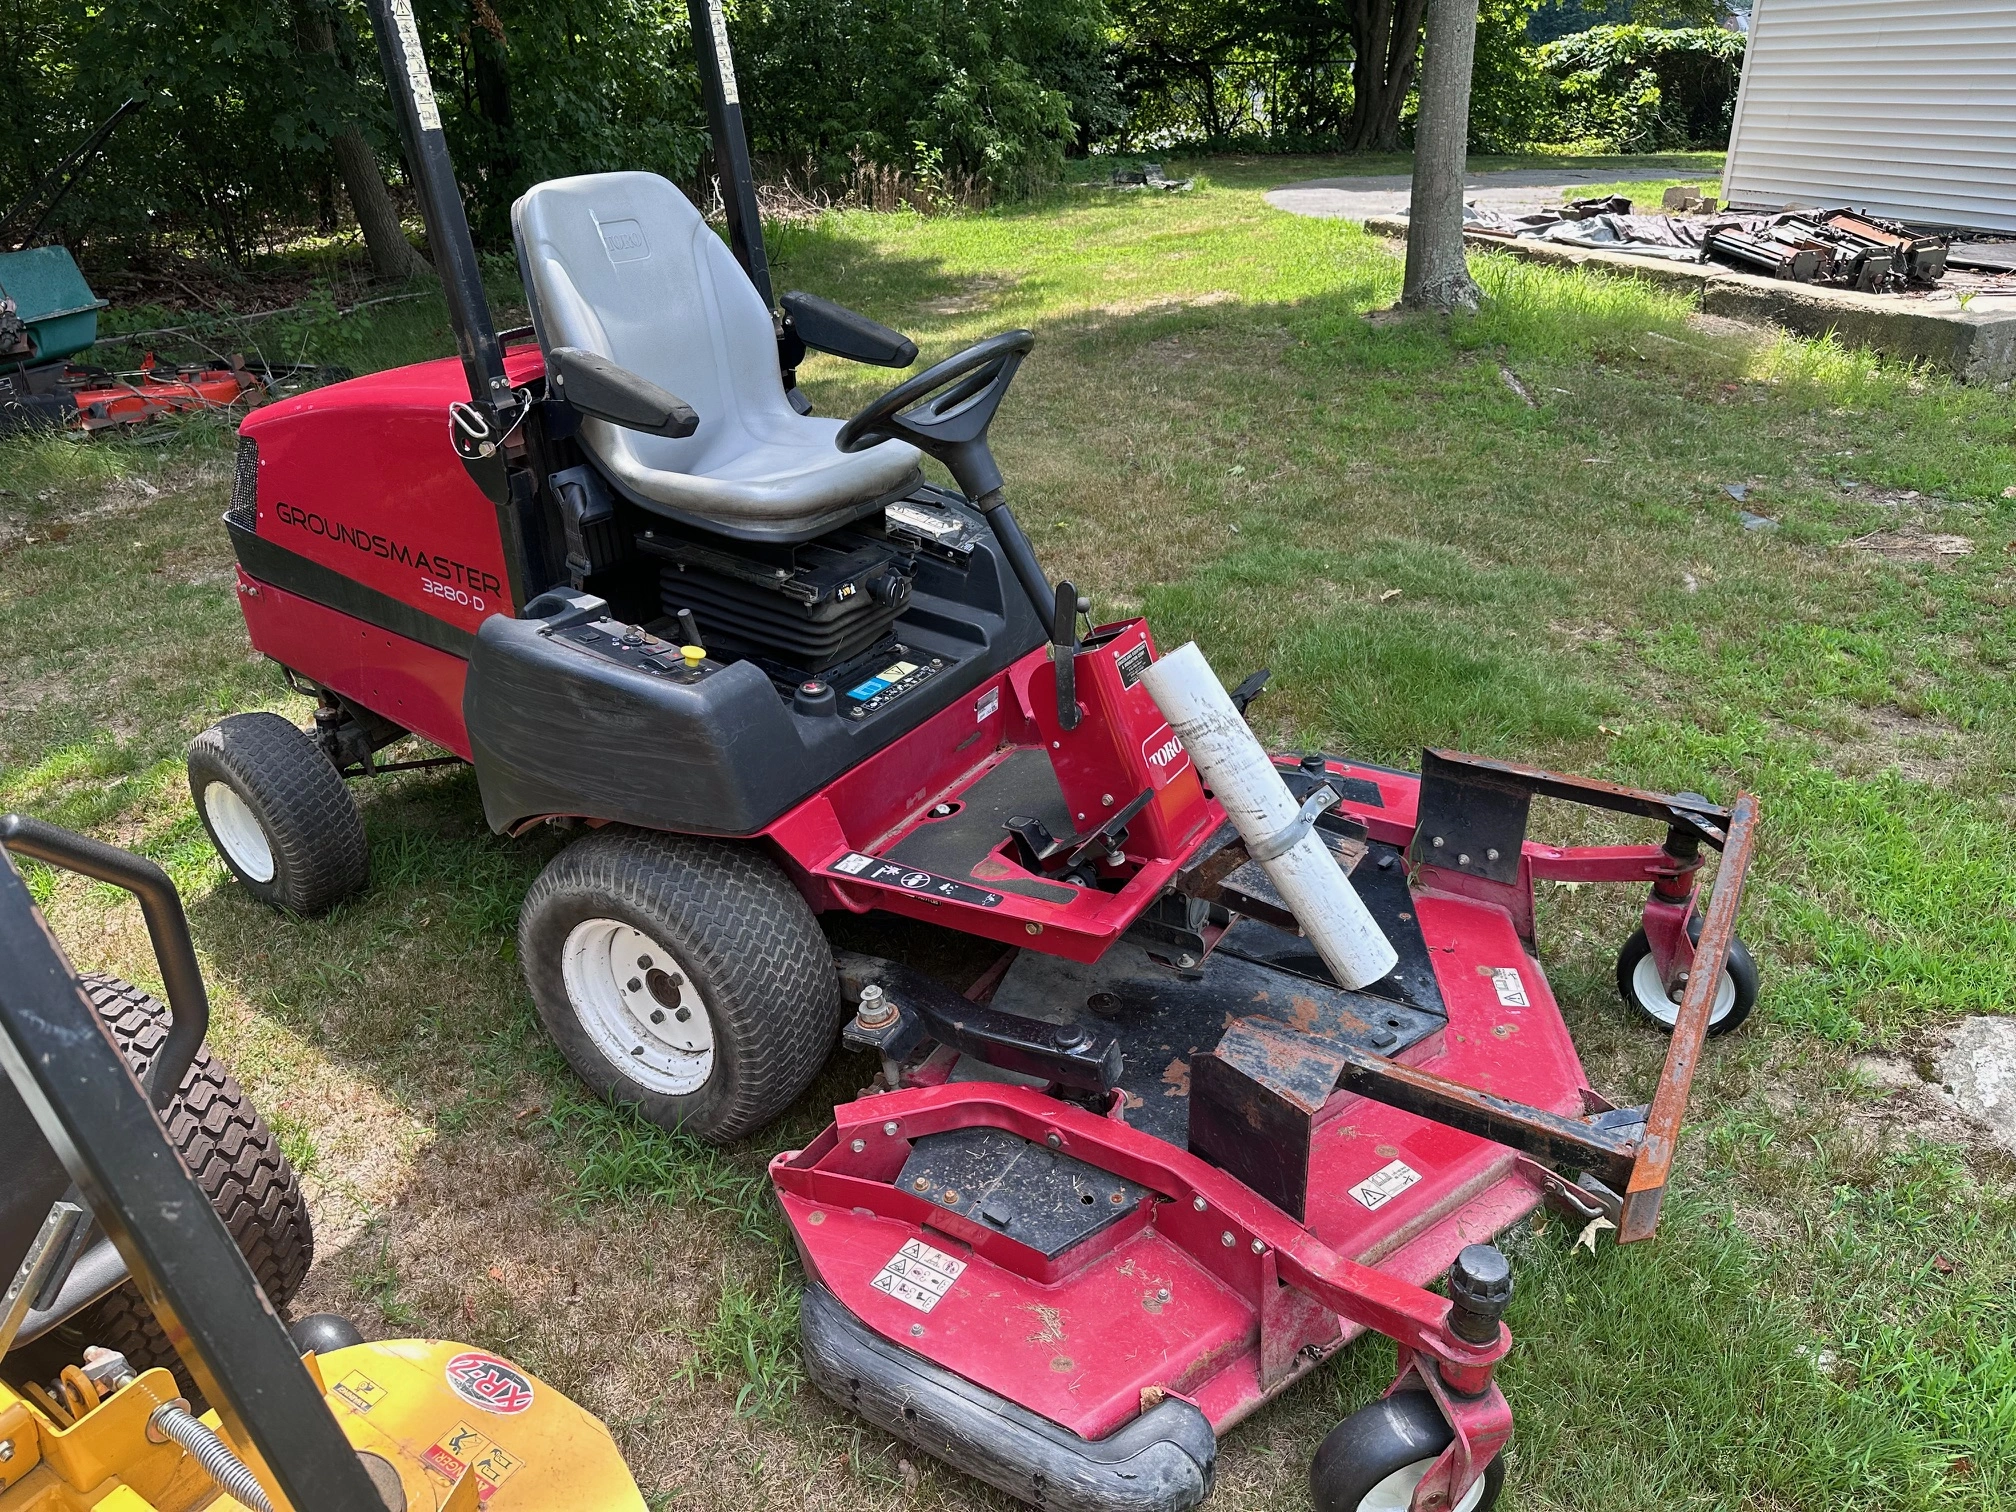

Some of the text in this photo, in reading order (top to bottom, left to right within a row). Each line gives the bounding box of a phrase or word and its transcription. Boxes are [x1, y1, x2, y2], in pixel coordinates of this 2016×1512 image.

[604, 232, 642, 252] TORO
[275, 501, 502, 598] GROUNDSMASTER
[1149, 735, 1183, 767] TORO
[448, 1359, 533, 1412] XR-7
[432, 1450, 472, 1481] NGER!
